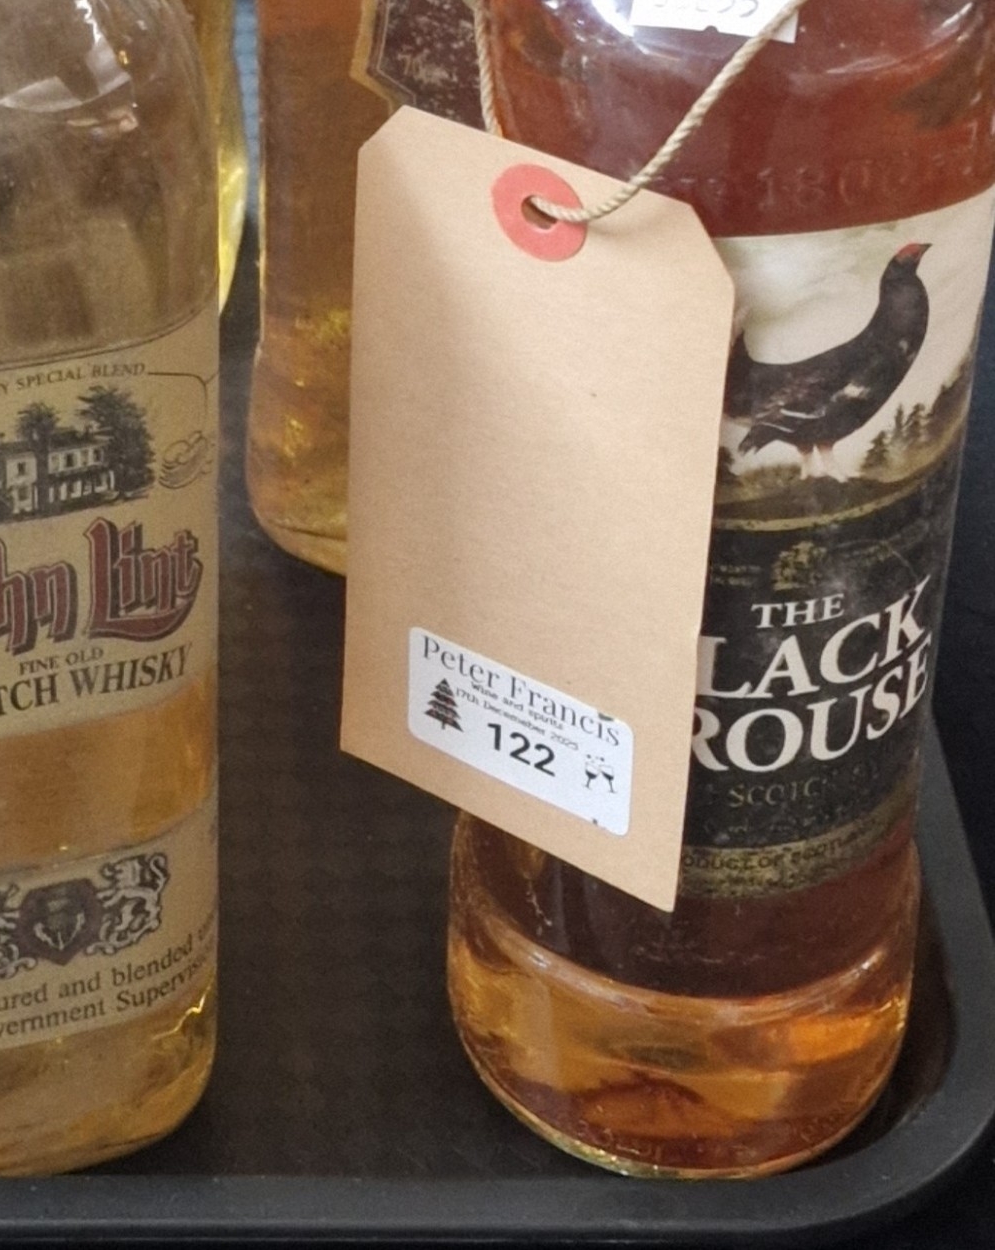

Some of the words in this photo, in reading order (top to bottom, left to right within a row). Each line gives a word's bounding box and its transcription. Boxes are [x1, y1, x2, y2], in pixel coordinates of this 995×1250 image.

[16, 366, 84, 392] SPECIAL
[91, 361, 147, 380] BLEND
[82, 516, 205, 644] Lint
[697, 574, 931, 700] LACK
[751, 592, 846, 629] THE
[17, 654, 60, 676] FINE
[65, 646, 105, 667] OLD
[70, 640, 194, 699] WHISKY
[421, 635, 501, 688] Peter
[509, 676, 621, 748] Francis
[470, 681, 499, 701] Wine
[503, 696, 524, 712] and
[527, 708, 564, 732] spirits
[691, 631, 933, 773] ROUSE
[487, 721, 557, 778] 122
[58, 973, 102, 1000] and
[111, 932, 193, 988] blended
